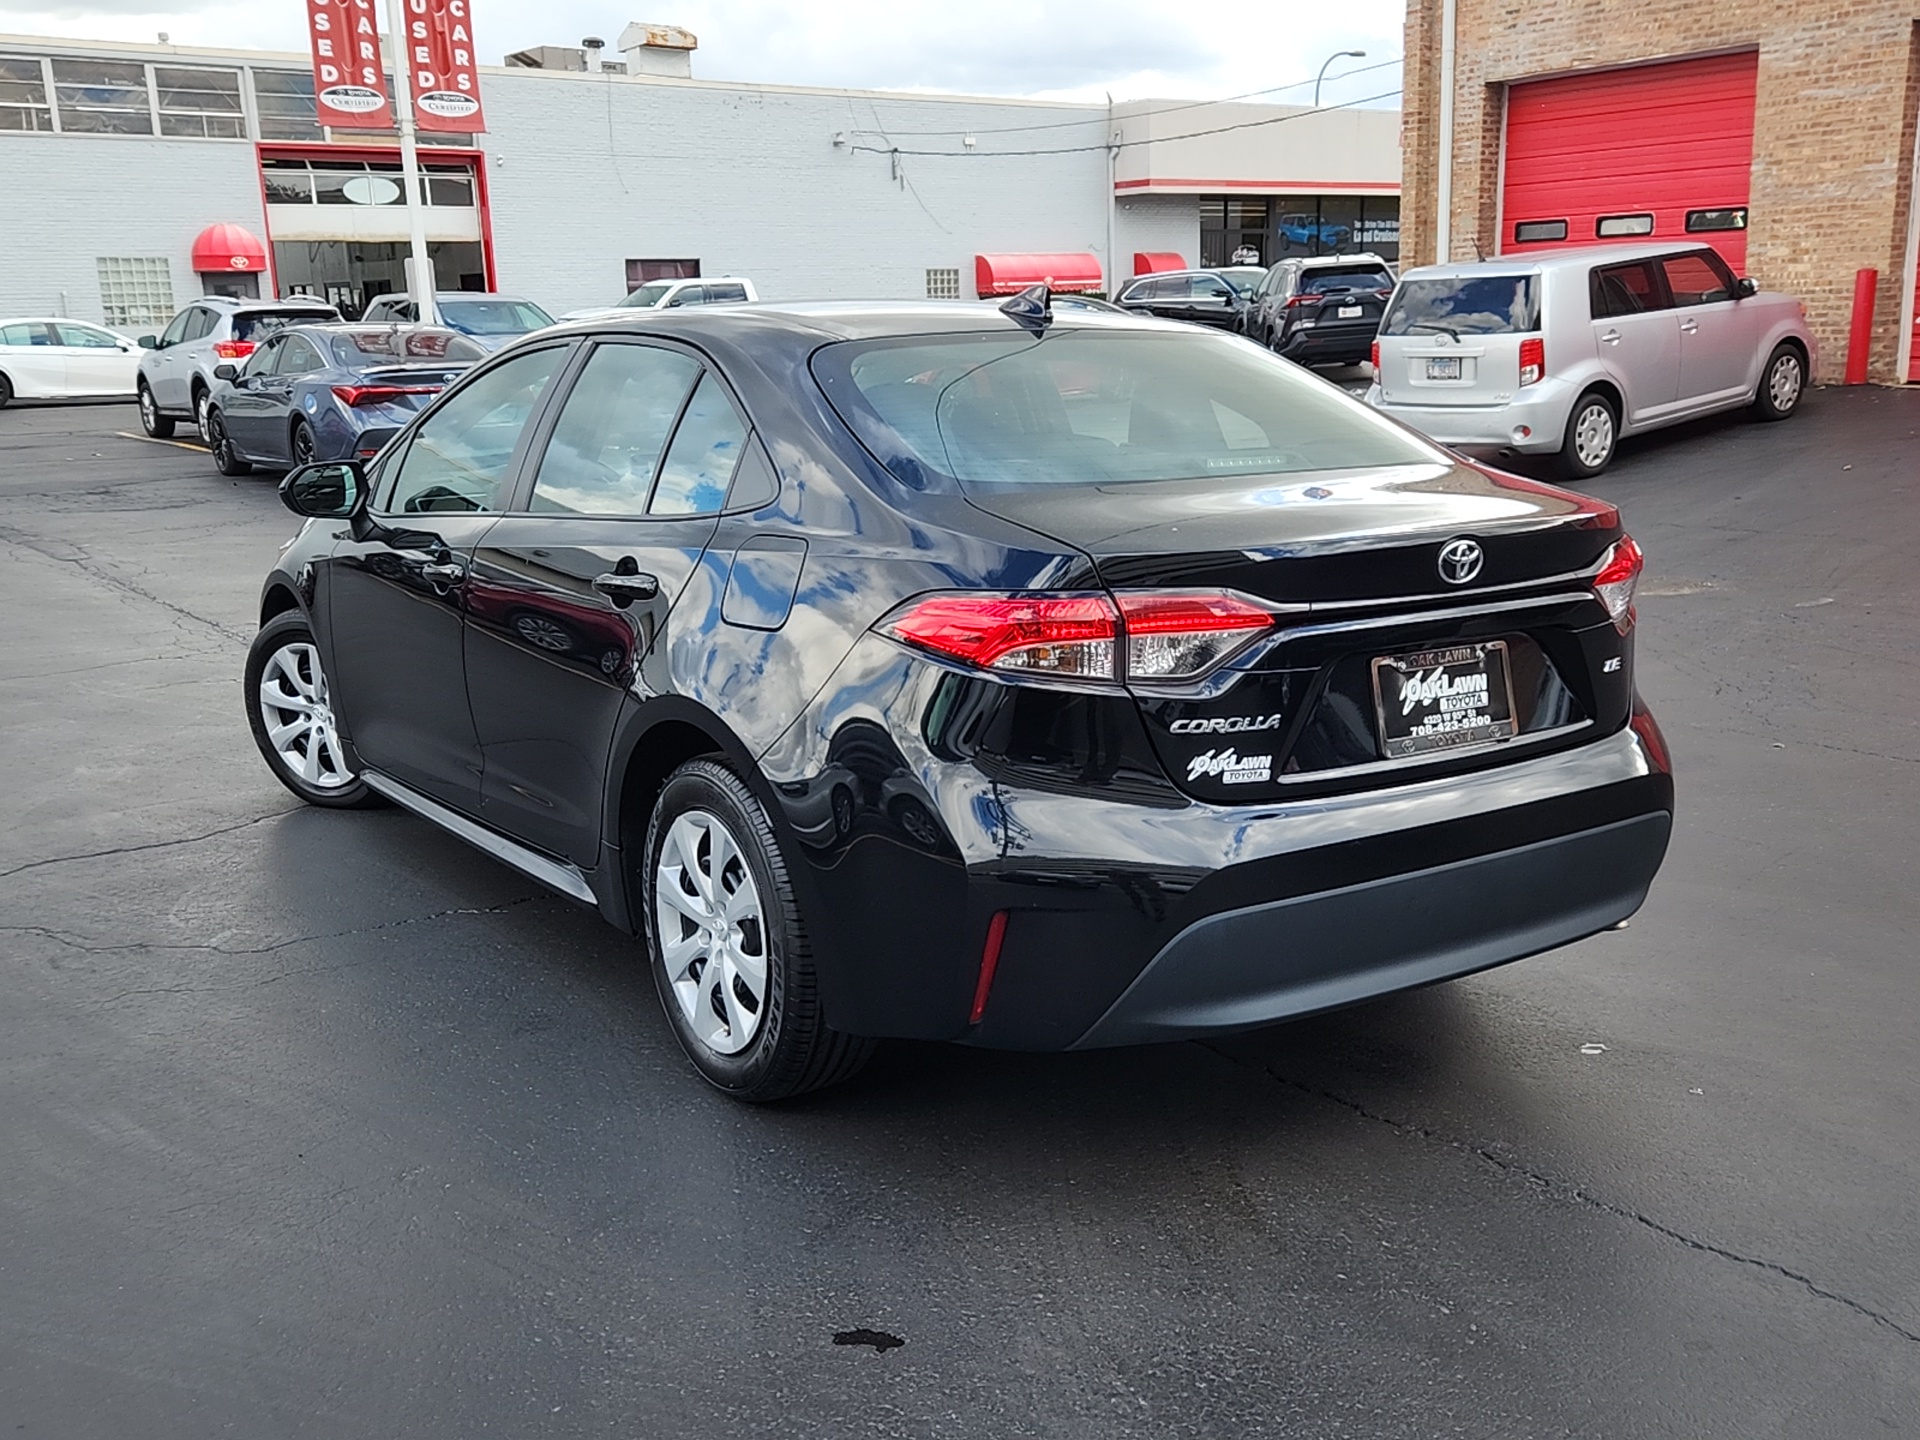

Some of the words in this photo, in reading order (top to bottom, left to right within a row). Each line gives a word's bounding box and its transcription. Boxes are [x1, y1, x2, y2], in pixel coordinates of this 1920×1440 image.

[410, 0, 436, 88] USED
[449, 0, 472, 90] CARS
[1410, 653, 1435, 667] OAK
[1438, 648, 1472, 664] LAWN
[1445, 693, 1484, 709] TOYOTA
[1169, 713, 1282, 734] COROLLA
[1410, 715, 1491, 737] 708-423-5200
[1427, 729, 1476, 746] TOYOTA
[1229, 770, 1264, 780] TOYOTA
